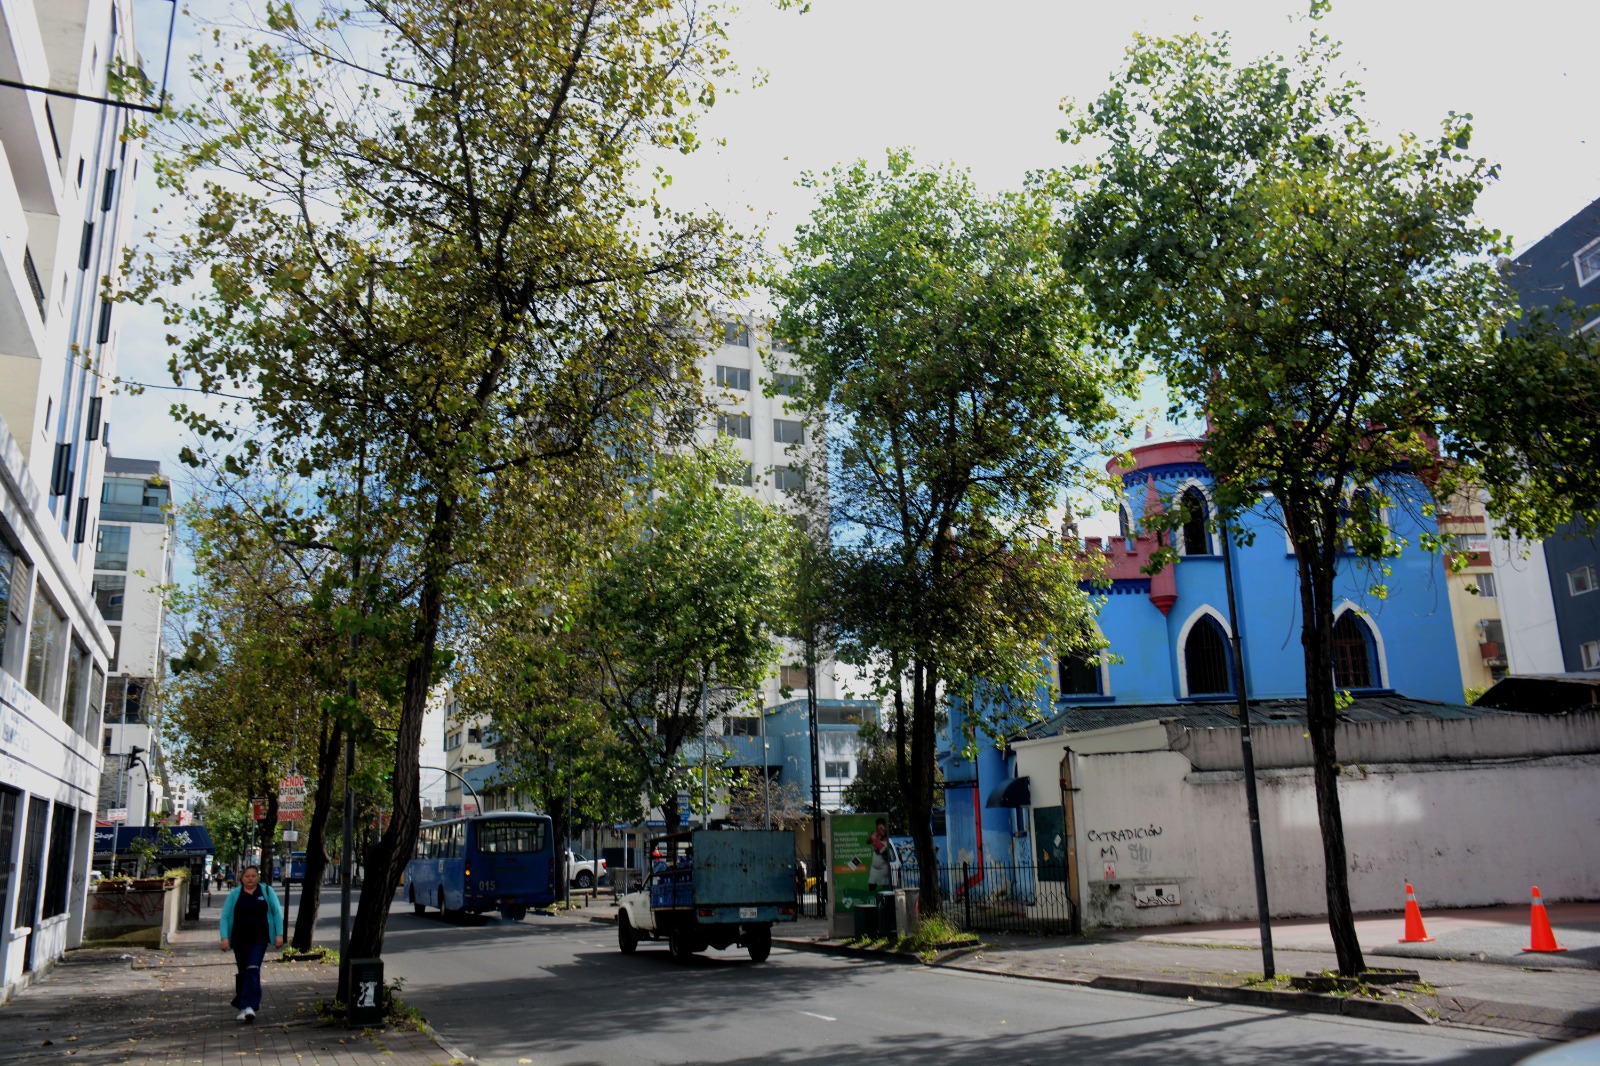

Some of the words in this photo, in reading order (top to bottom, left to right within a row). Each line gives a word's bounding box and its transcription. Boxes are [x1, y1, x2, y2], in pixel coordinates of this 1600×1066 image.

[280, 775, 304, 787] VENDO
[280, 787, 305, 796] OFICINA
[479, 881, 495, 891] 015
